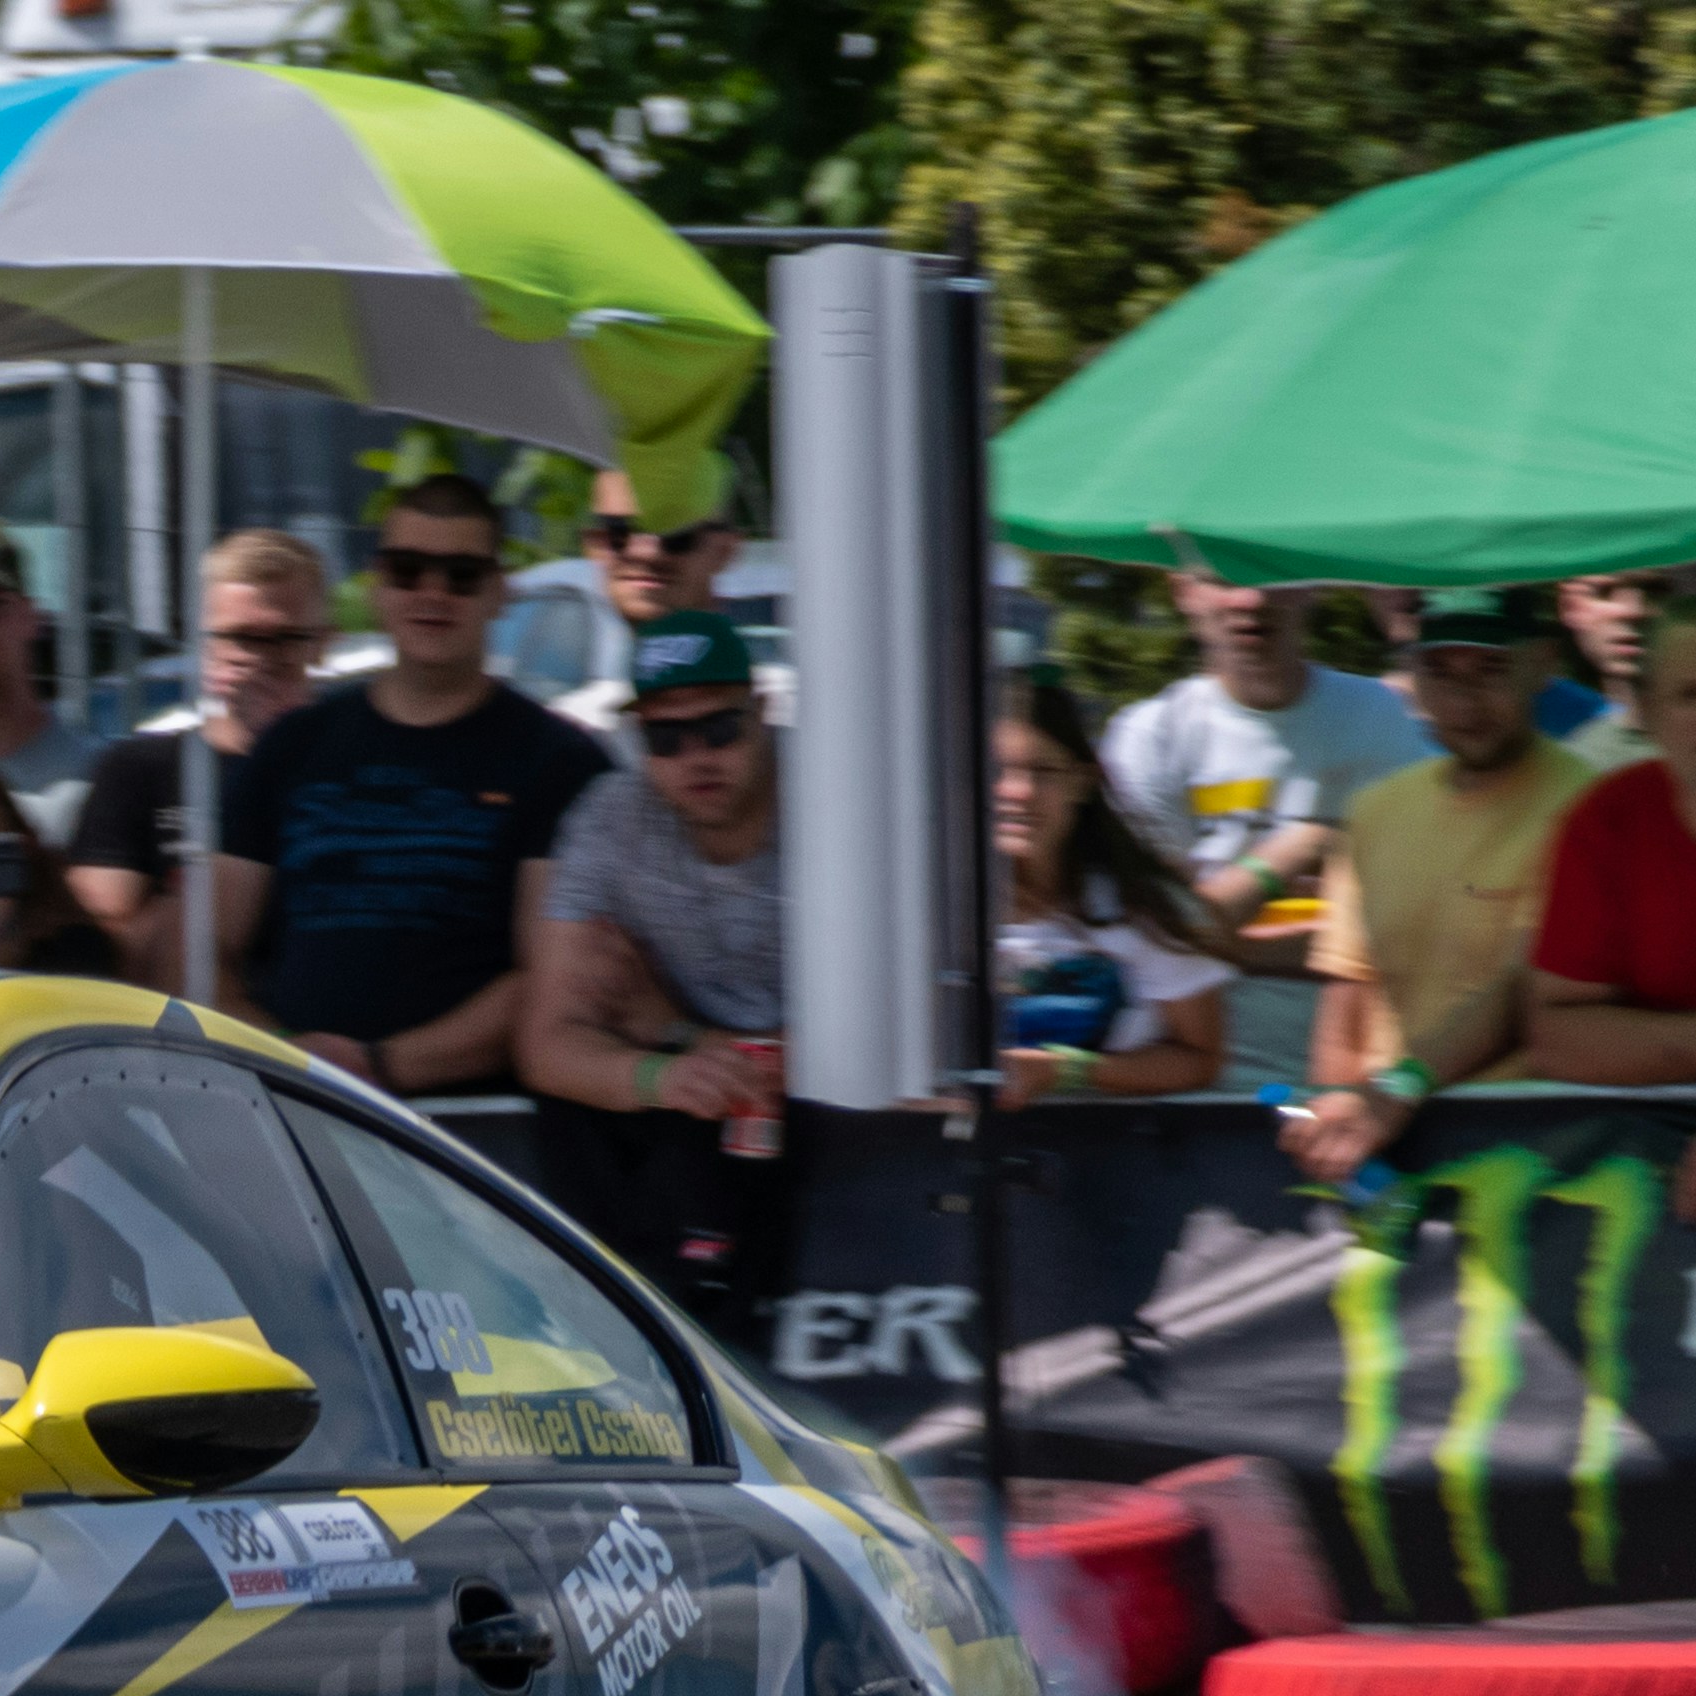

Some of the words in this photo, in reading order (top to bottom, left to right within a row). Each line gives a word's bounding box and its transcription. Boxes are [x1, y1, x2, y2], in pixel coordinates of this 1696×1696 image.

[383, 1287, 495, 1375] 388
[576, 1399, 686, 1458] Csaba
[196, 1507, 276, 1563] 388
[562, 1504, 674, 1654] ENEOS
[662, 1575, 702, 1639] OIL
